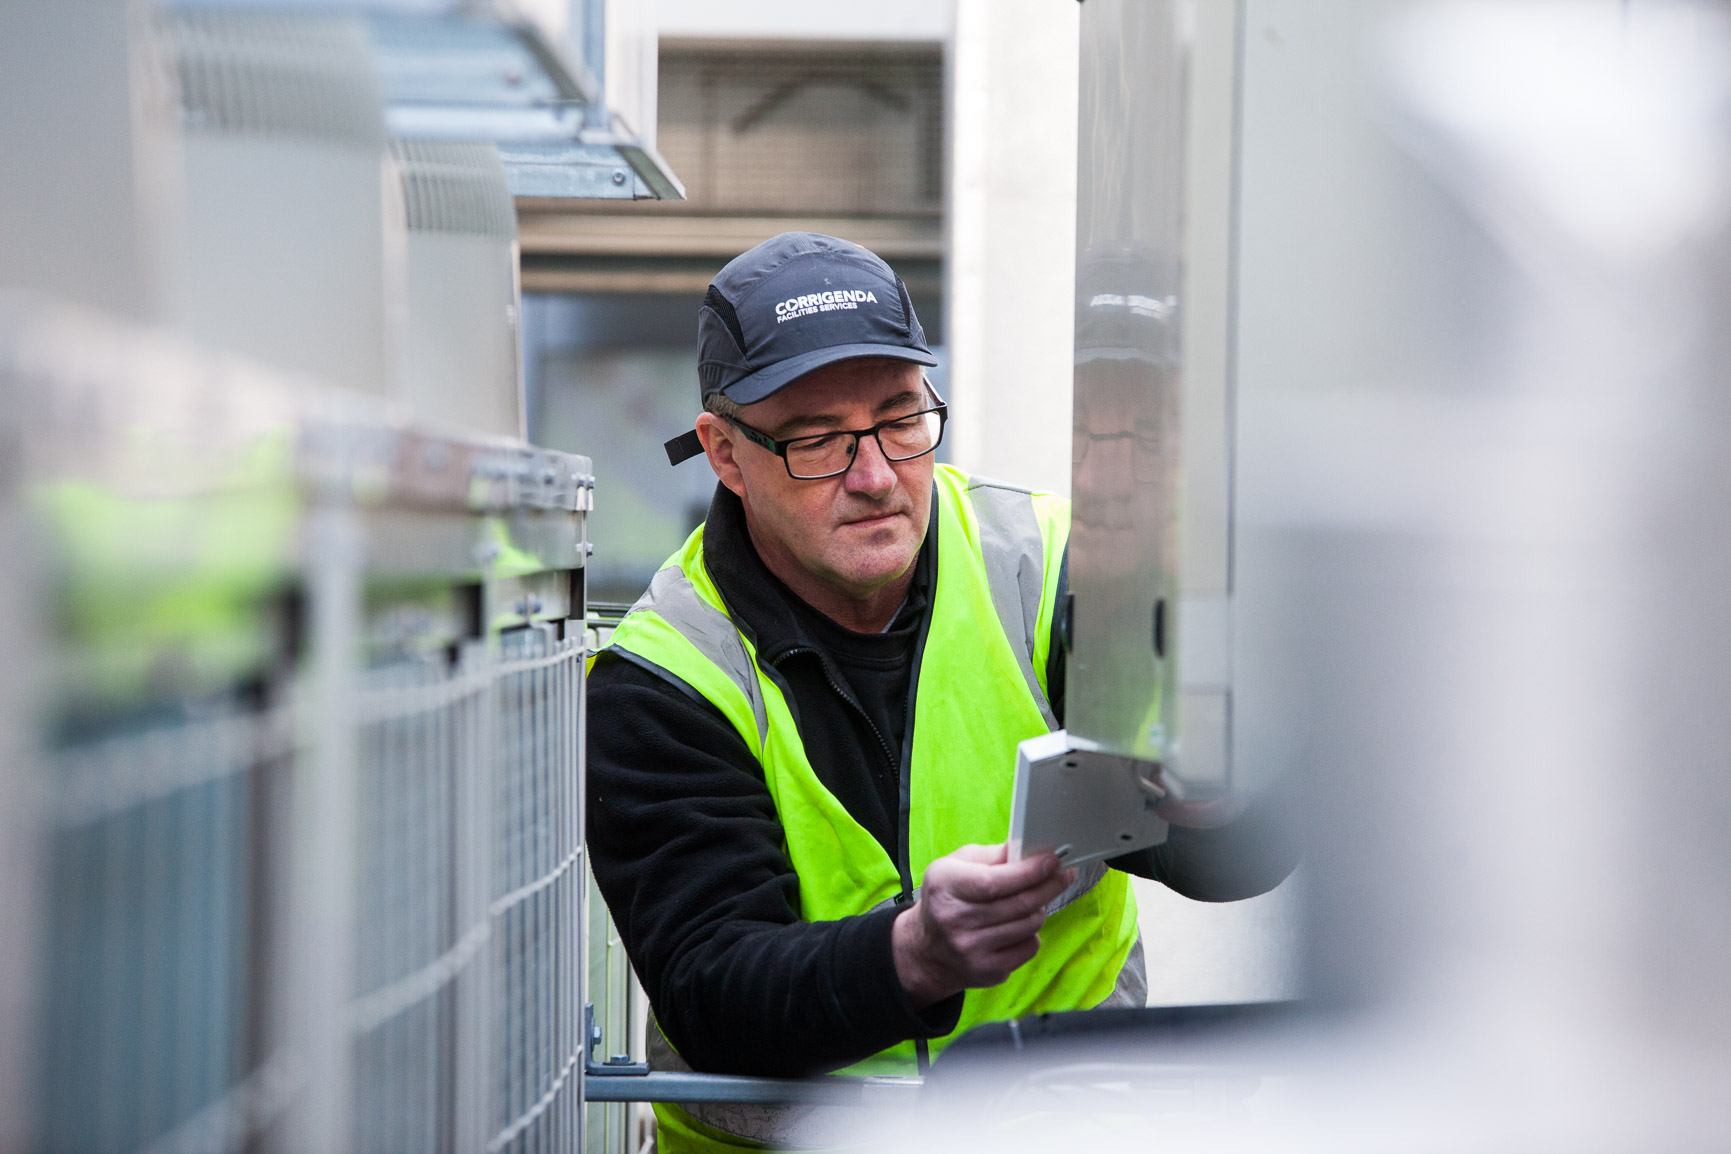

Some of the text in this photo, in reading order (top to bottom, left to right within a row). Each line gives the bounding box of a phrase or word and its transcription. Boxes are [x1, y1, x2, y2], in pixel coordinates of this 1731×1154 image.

[775, 290, 878, 315] CORRIGENDA
[776, 302, 858, 324] FACILITIES SERVICES
